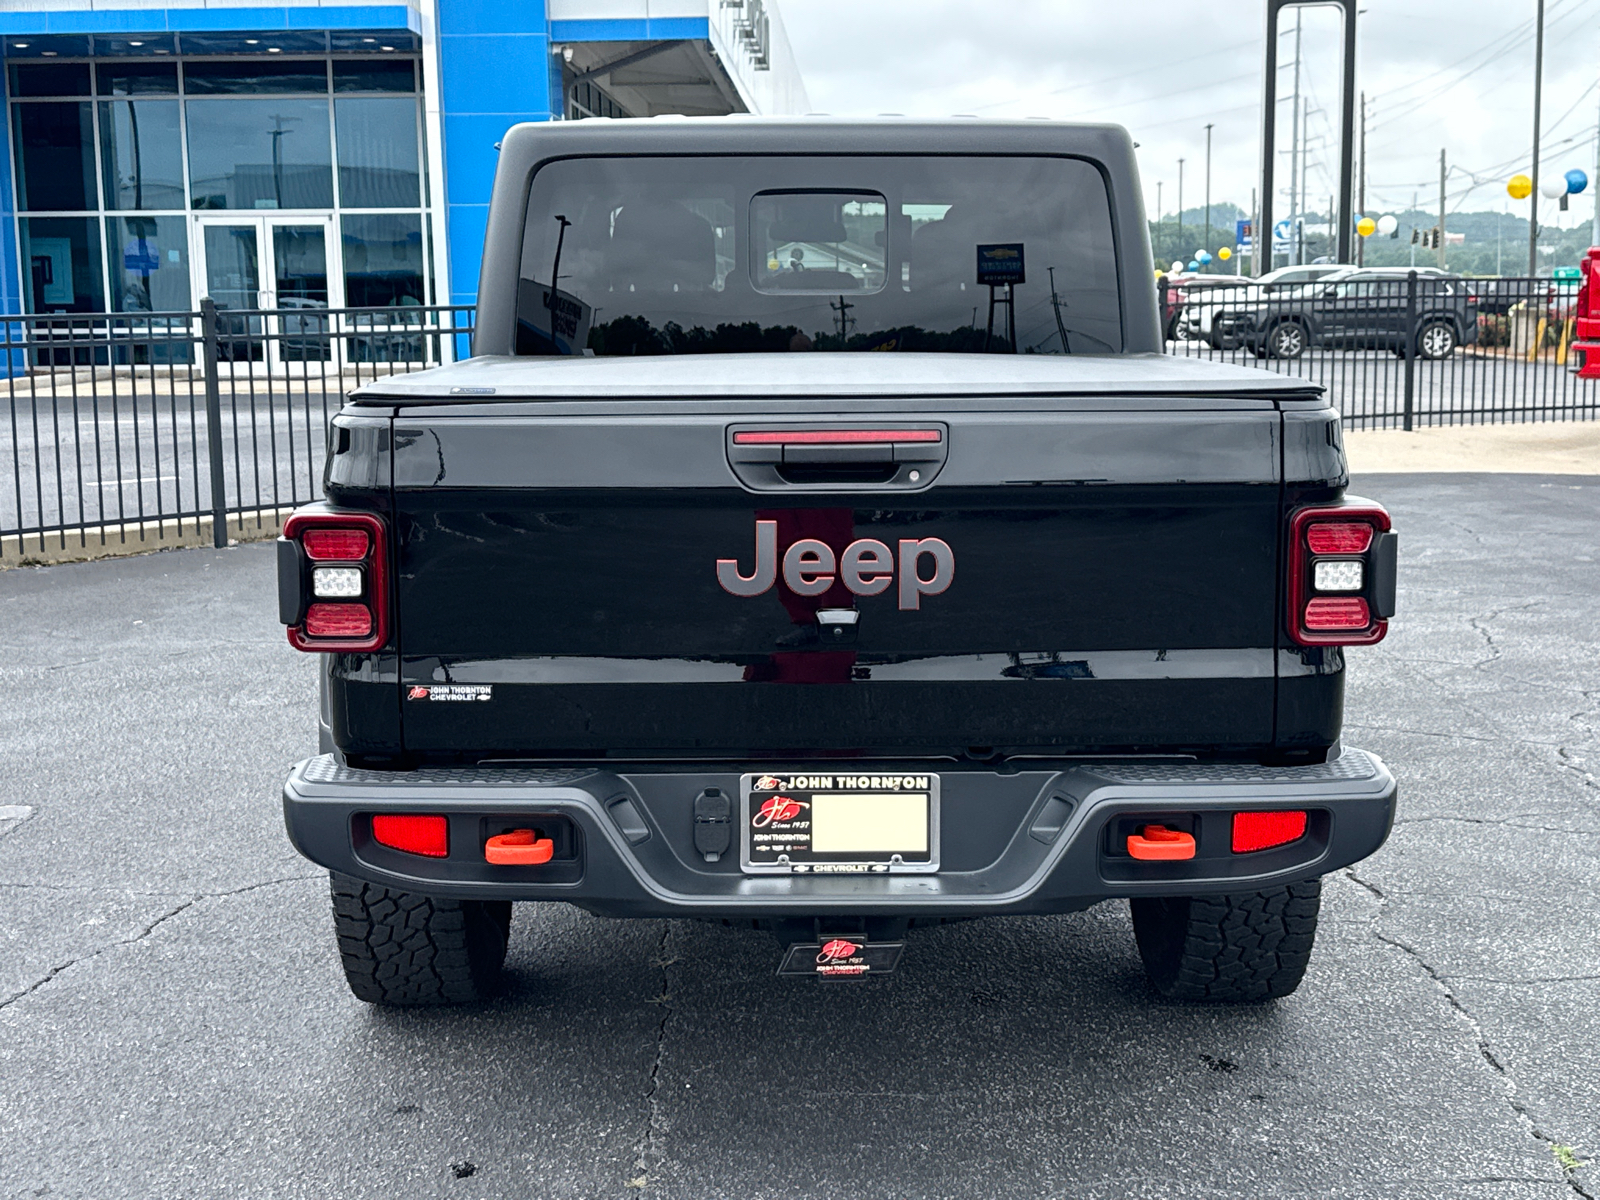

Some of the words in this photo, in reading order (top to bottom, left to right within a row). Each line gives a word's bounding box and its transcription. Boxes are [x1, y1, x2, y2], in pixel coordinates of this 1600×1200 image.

[716, 520, 955, 610] Jeep
[430, 686, 450, 694] JOHN
[450, 686, 491, 694] THORNTON
[430, 693, 476, 701] CHEVROLET
[787, 776, 833, 789] JOHN
[836, 776, 928, 789] THORNTON
[772, 833, 810, 841] THORNTON
